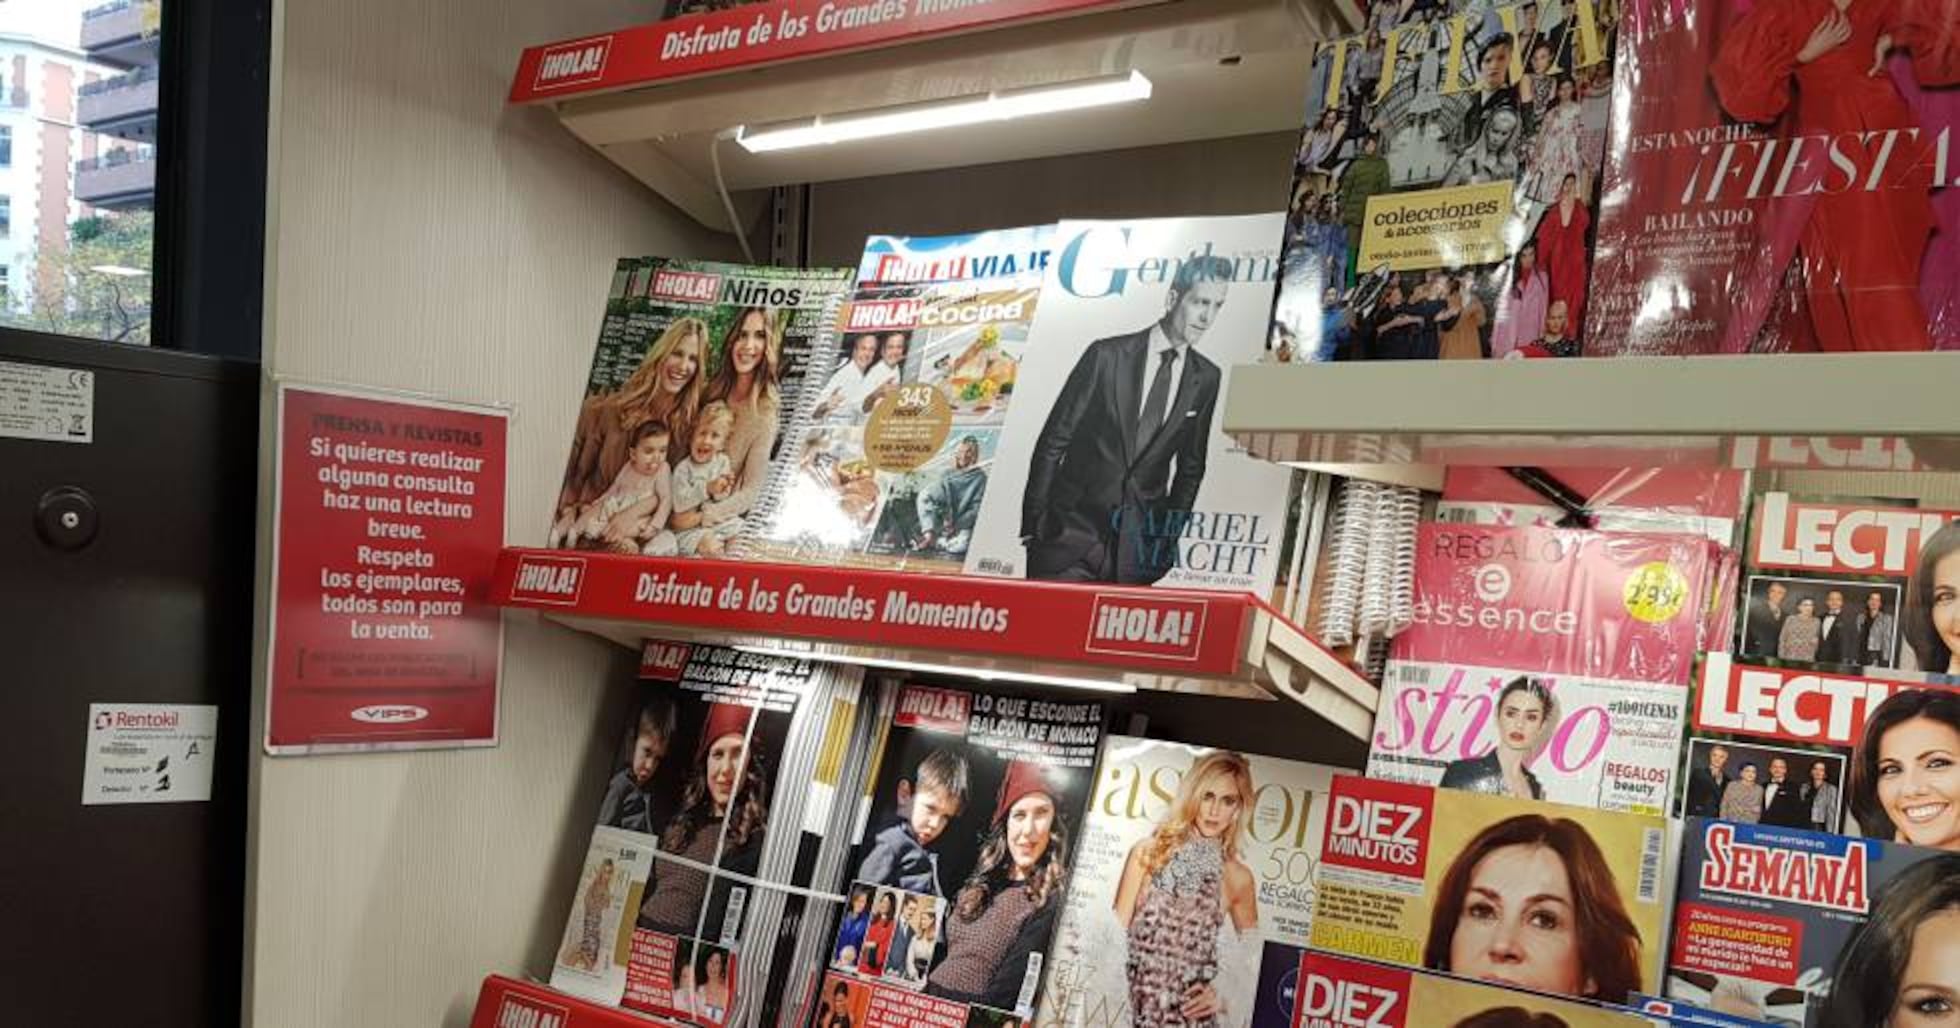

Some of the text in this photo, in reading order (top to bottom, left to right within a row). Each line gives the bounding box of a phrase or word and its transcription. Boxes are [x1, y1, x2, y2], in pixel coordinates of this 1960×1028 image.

[661, 26, 742, 60] Disfruta
[746, 12, 772, 46] de
[777, 9, 809, 40] los
[815, 1, 906, 34] Grandes
[541, 46, 604, 81] ¡HOLA!
[1631, 133, 1677, 153] ESTA
[1680, 126, 1960, 204] ¡FIESTA
[1373, 199, 1499, 227] colecciones
[1644, 208, 1754, 232] BAILANDO
[654, 271, 714, 300] ¡HOLA!
[723, 278, 802, 306] Niños
[850, 303, 918, 329] ¡HOLA!
[897, 386, 932, 407] 343
[311, 413, 385, 436] PRENSA
[404, 423, 483, 447] REVISTAS
[309, 437, 485, 473] Si quieres realizar
[318, 462, 475, 496] alguna consulta
[322, 488, 474, 519] haz una lectura
[367, 518, 427, 540] breve.
[1110, 504, 1271, 545] GABRIEL
[356, 545, 435, 571] Respeta
[1134, 540, 1267, 576] MACHT
[1433, 533, 1567, 565] REGALO
[320, 567, 466, 596] los ejemplares,
[321, 593, 463, 620] todos son para
[517, 562, 1195, 646] ¡HOLA! Disfruta de los Grandes Momentos ¡HOLA!
[1411, 598, 1579, 635] essence
[350, 619, 434, 641] la venta.
[692, 646, 709, 662] LO
[711, 648, 739, 666] QUE
[116, 710, 179, 728] Rentokil
[364, 708, 418, 720] VIPS
[901, 690, 1102, 722] ¡HOLA! LO QUE ESCONDE EL
[970, 714, 1099, 744] BALCÓN DE MÓNACO
[1375, 669, 1611, 775] stio
[1606, 762, 1665, 783] REGALOS
[1613, 780, 1655, 797] beauty
[1330, 794, 1424, 848] DIEZ
[1328, 836, 1418, 866] MINUTOS
[1702, 825, 1868, 912] SEMANA
[1312, 922, 1420, 965] CARMEN
[1775, 946, 1790, 960] de
[1301, 973, 1399, 1028] DIEZ
